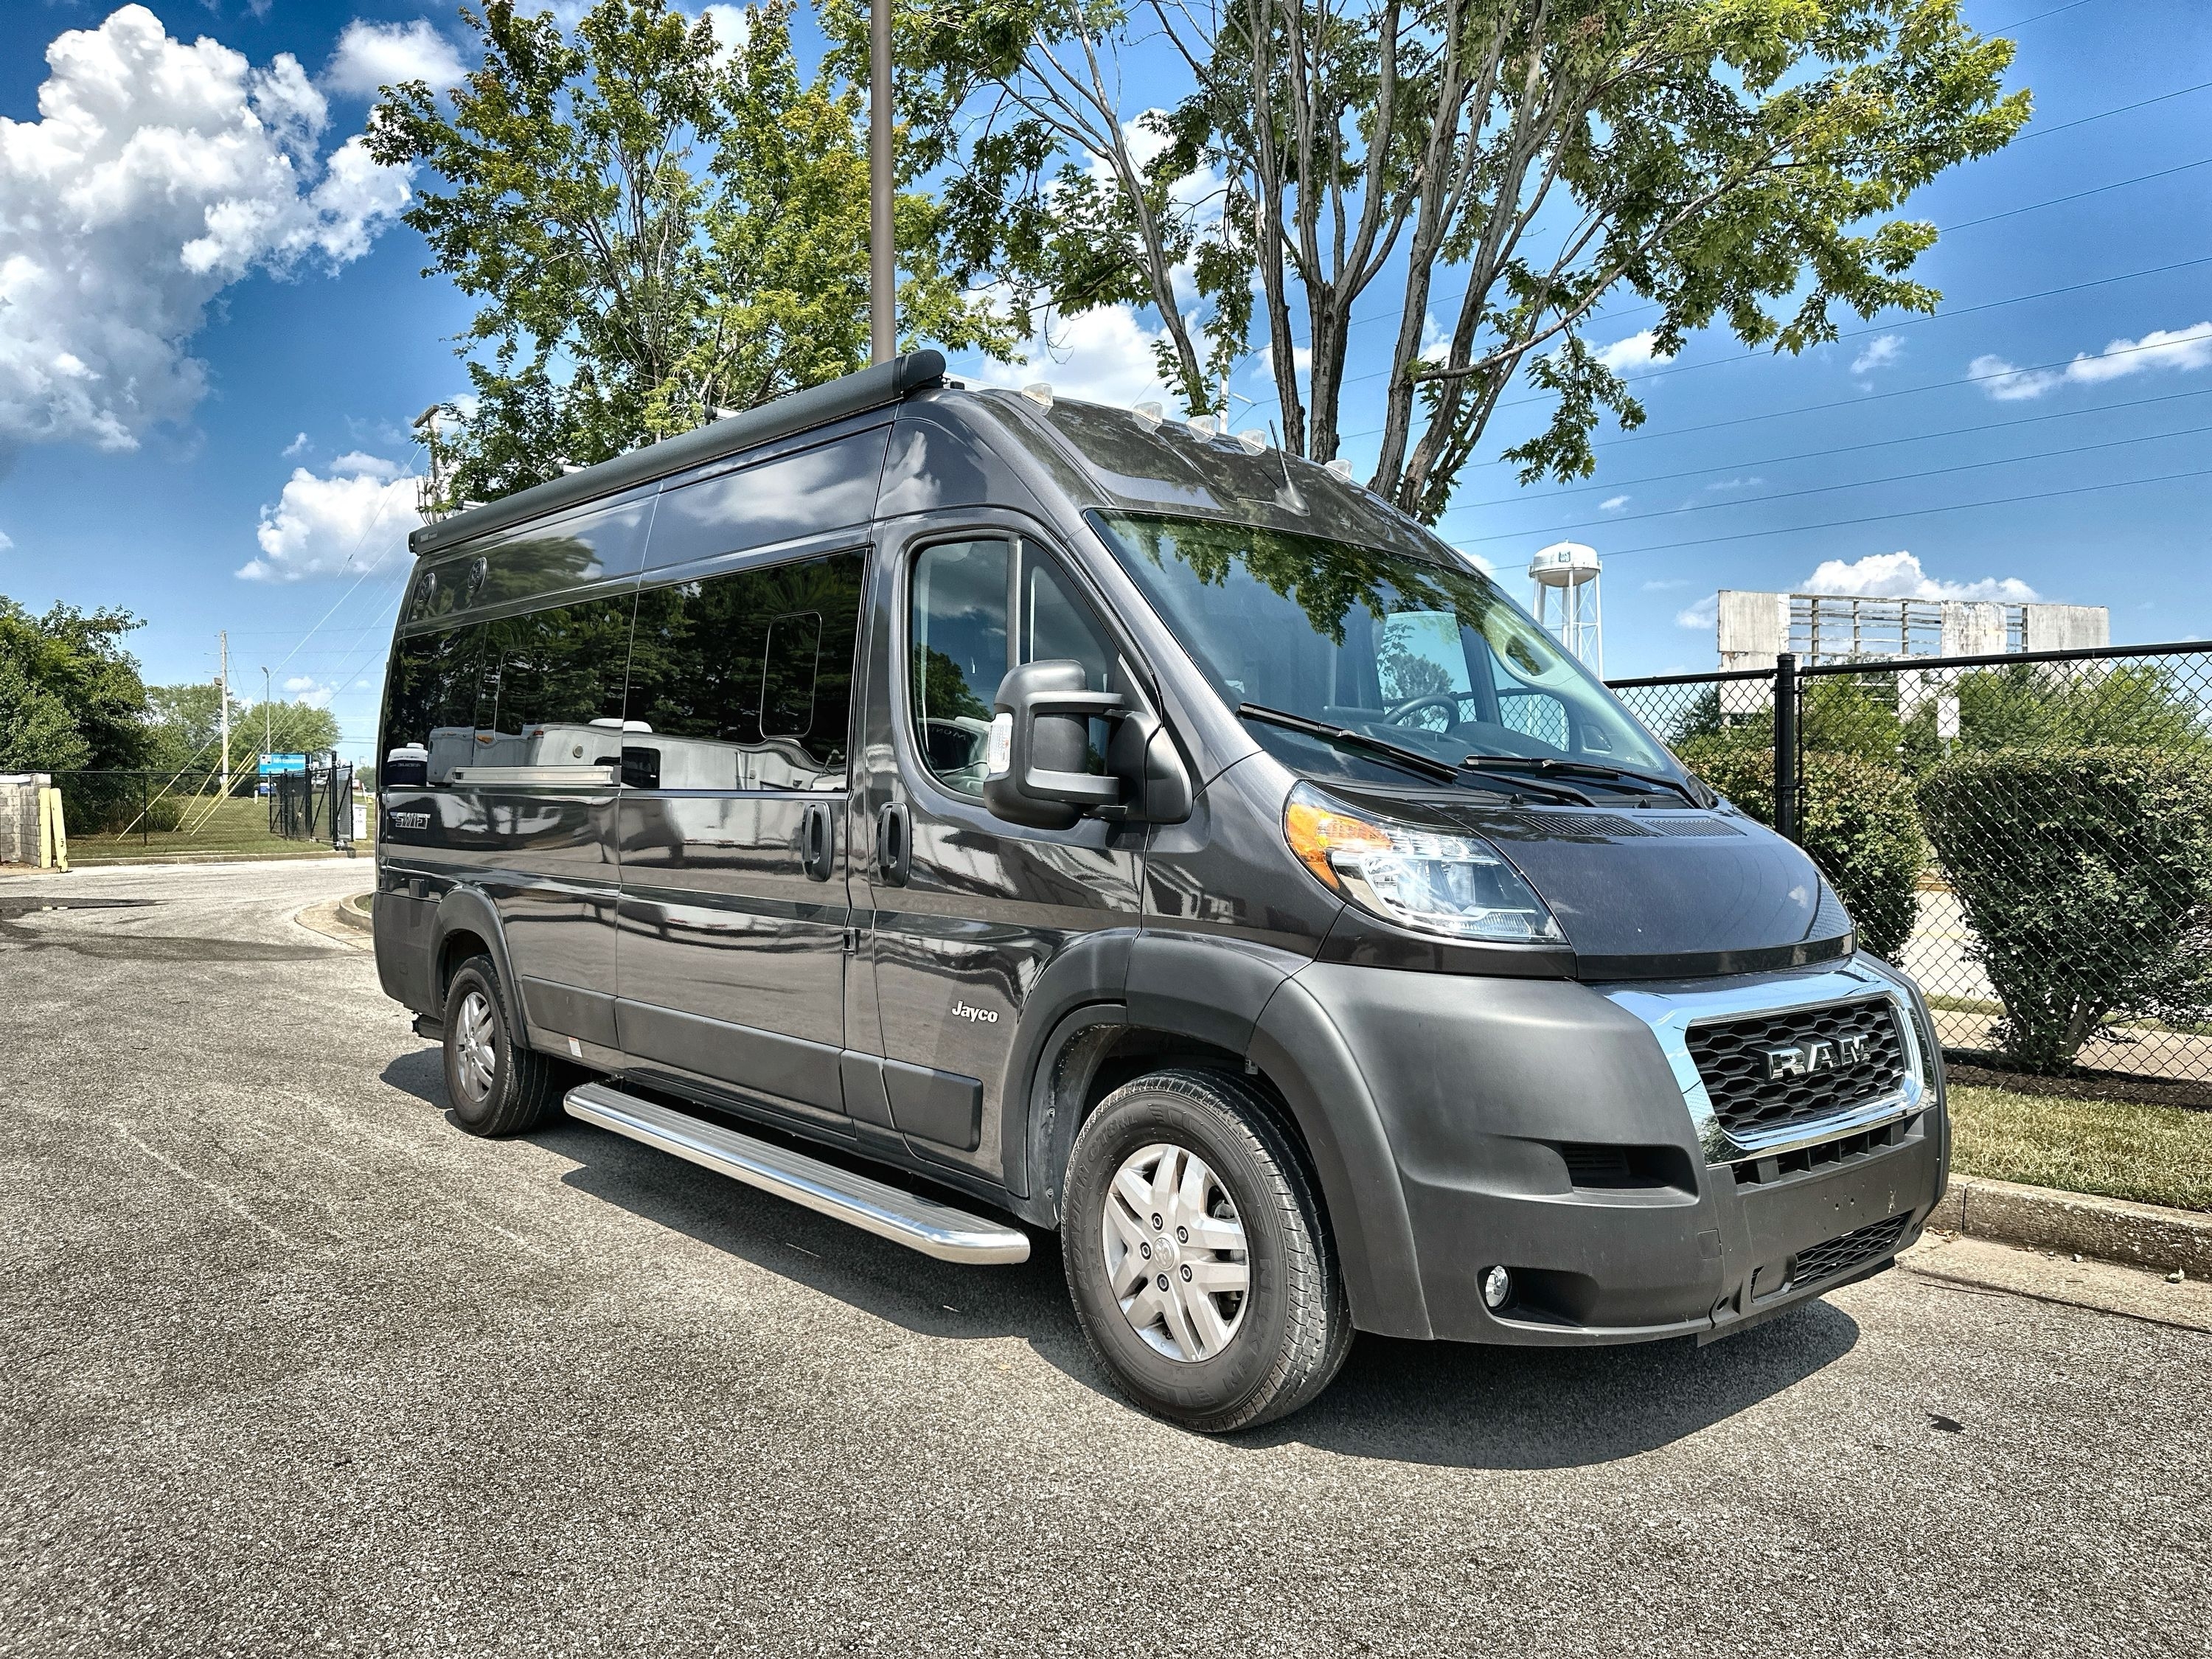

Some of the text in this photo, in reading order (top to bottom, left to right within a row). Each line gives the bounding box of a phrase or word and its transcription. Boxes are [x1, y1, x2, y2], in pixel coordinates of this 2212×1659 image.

[395, 812, 431, 830] SWIFT
[951, 1000, 999, 1023] Jayco
[1769, 1034, 1871, 1080] RAM
